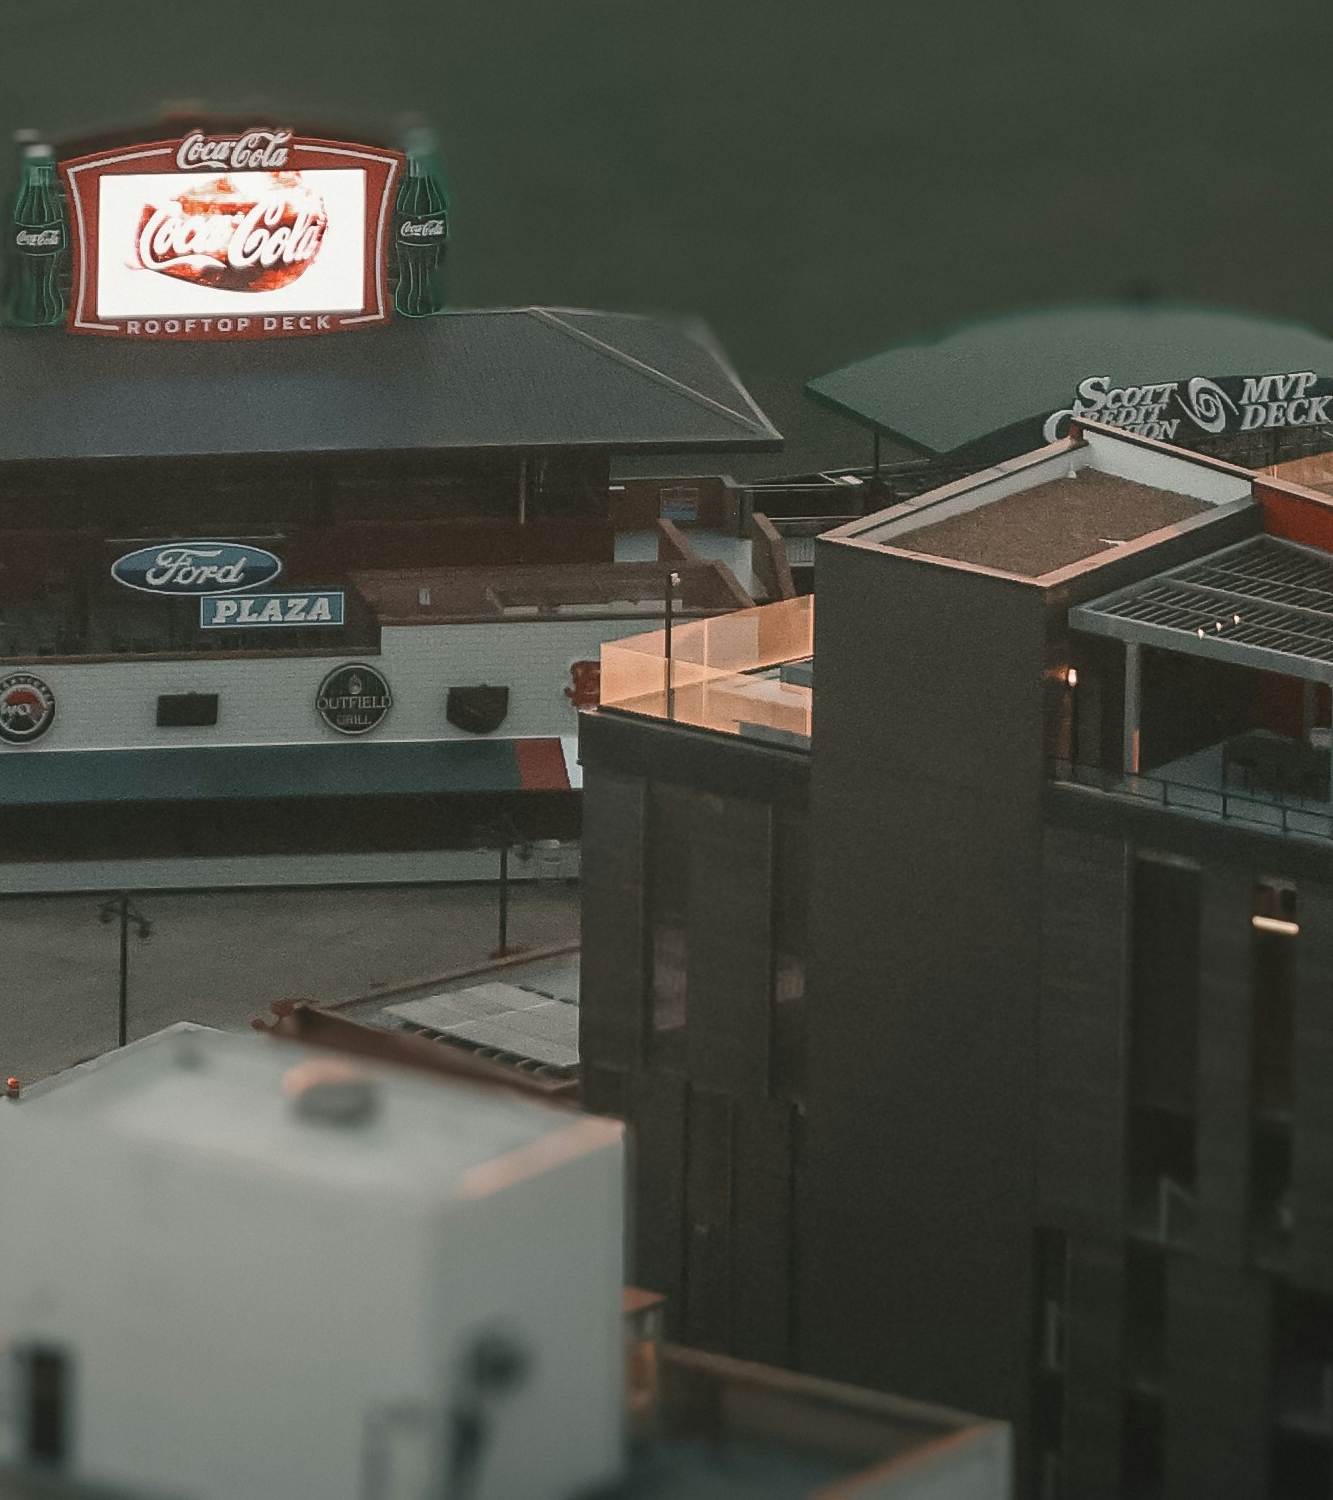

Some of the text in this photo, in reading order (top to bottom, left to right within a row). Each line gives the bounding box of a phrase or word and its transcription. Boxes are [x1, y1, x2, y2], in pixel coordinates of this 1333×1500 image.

[176, 132, 294, 169] Coca-Cola
[127, 315, 331, 335] ROOFTOP DECK
[1077, 376, 1179, 412] SCOTT
[1238, 371, 1318, 405] MVP
[1239, 395, 1333, 431] DECK
[145, 548, 247, 586] Ford
[211, 597, 332, 625] PLAZA
[316, 696, 393, 710] OUTFIELD
[336, 714, 372, 726] GRILL
